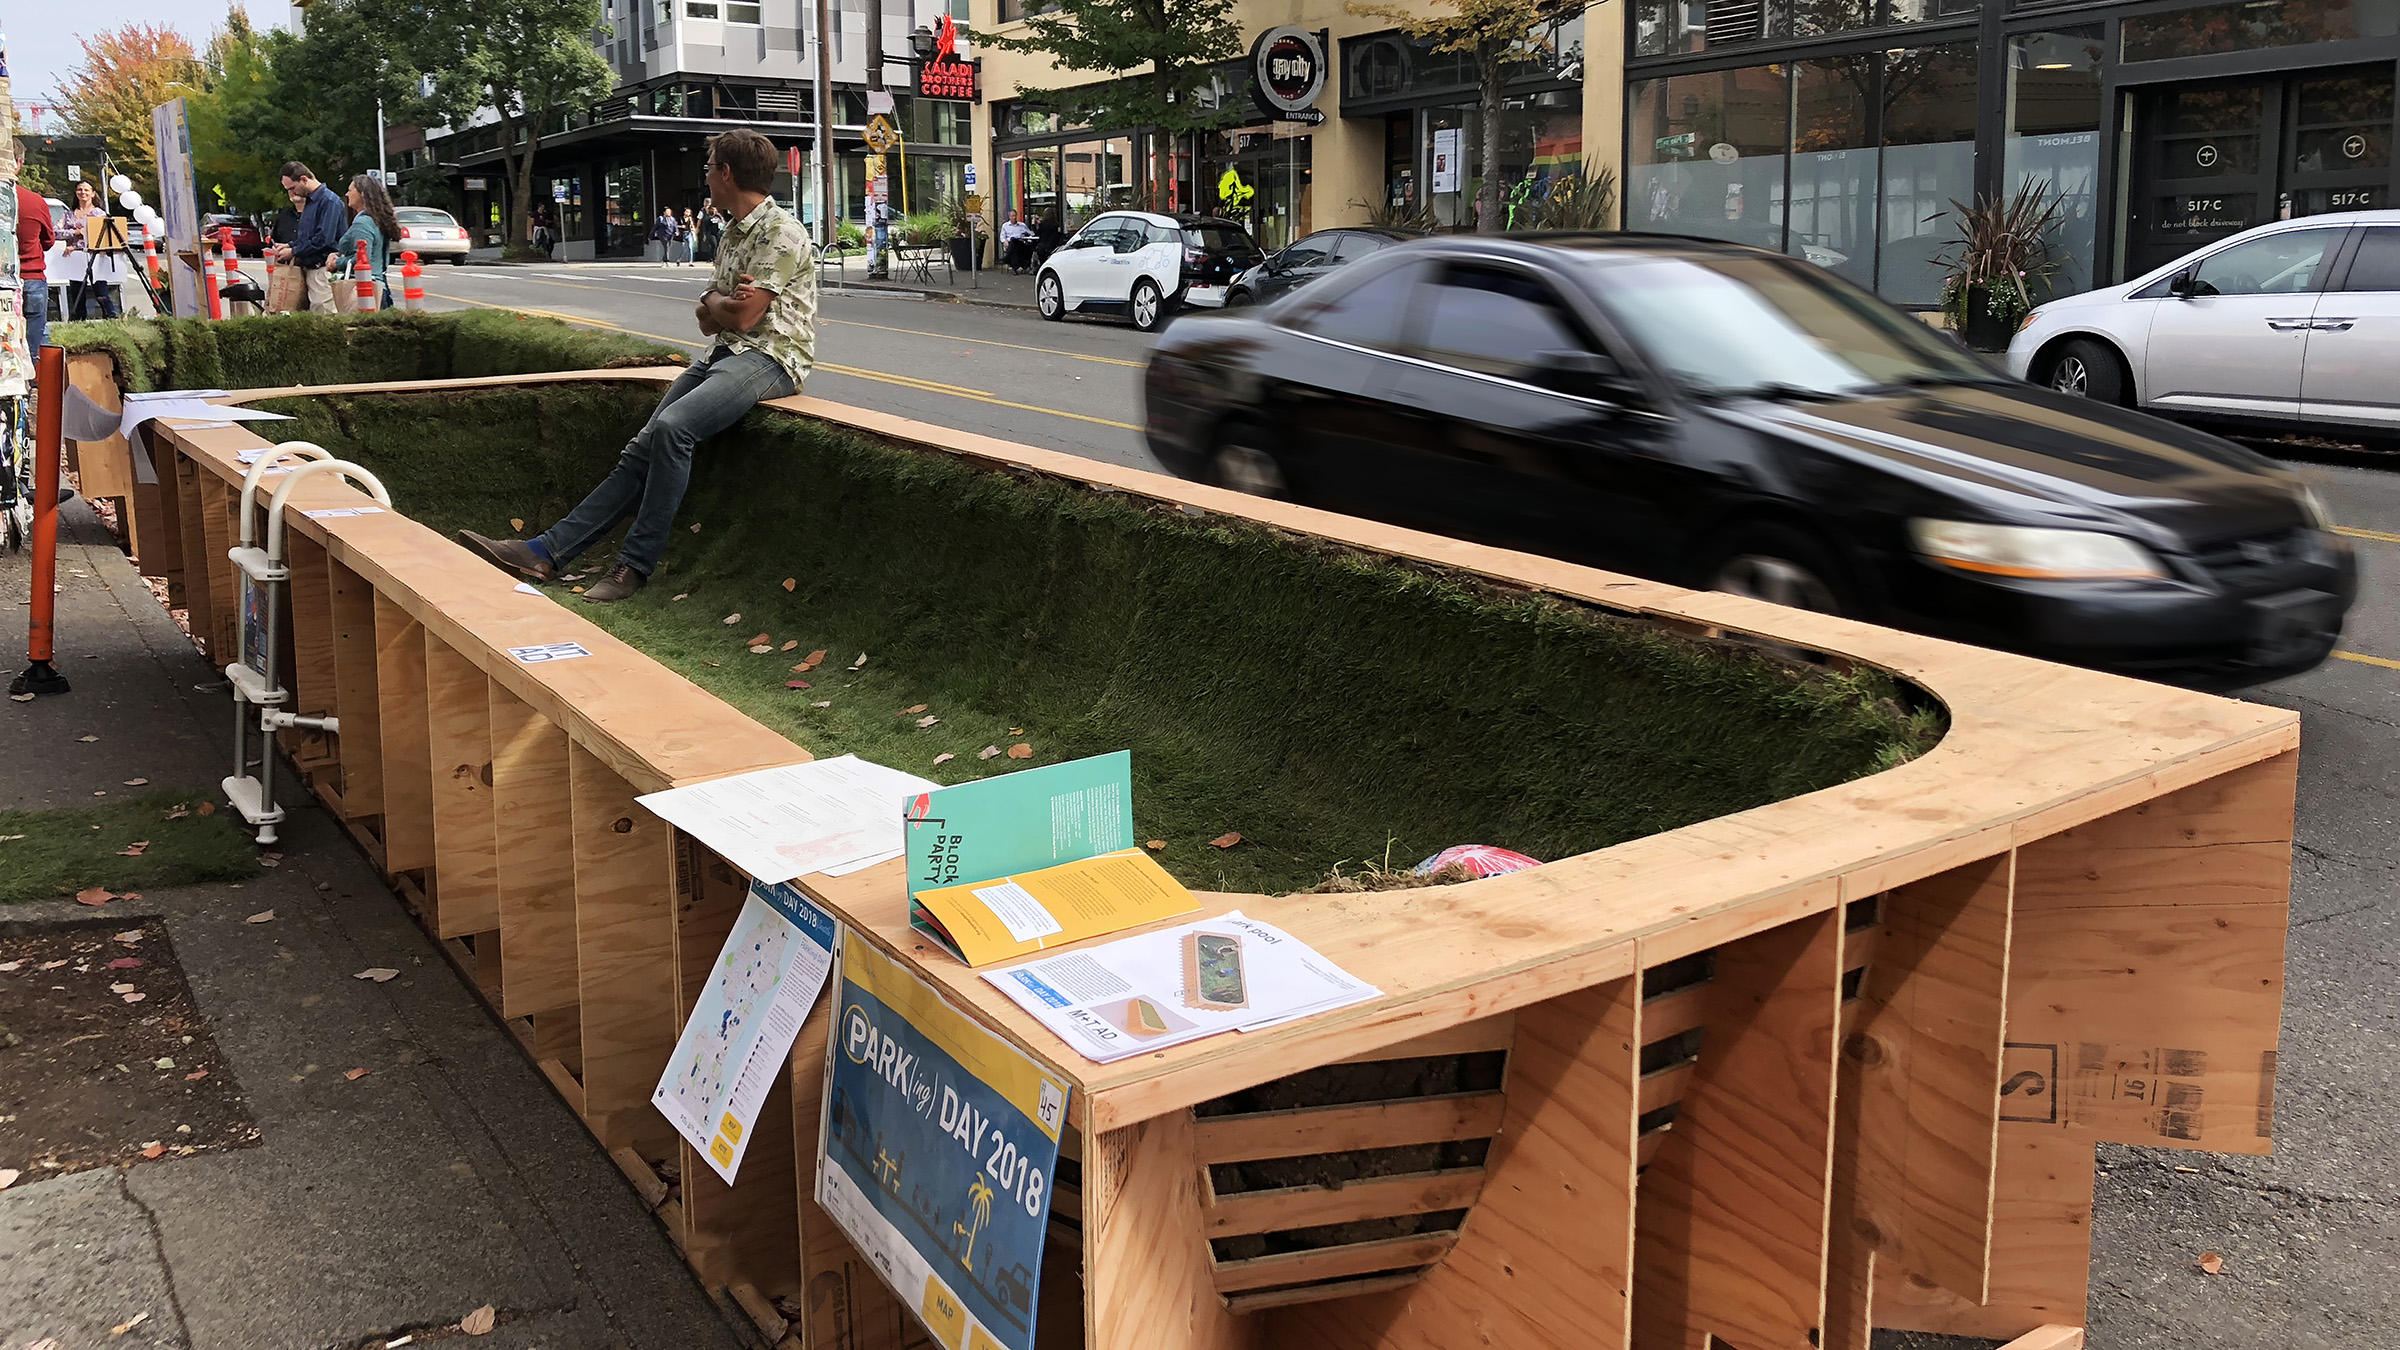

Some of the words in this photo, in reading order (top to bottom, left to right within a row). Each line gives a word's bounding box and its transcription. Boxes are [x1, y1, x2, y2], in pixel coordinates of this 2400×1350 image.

[921, 61, 974, 77] KALADI
[921, 74, 974, 87] BROTHERS
[921, 83, 974, 98] COFFEE
[1285, 111, 1318, 121] ENTRANCE
[1239, 134, 1251, 148] 517
[2161, 219, 2171, 229] do
[2173, 219, 2186, 229] not
[2188, 217, 2208, 228] block
[923, 834, 947, 885] PARTY
[783, 890, 798, 913] DAY
[799, 903, 818, 928] 2018
[1246, 928, 1283, 945] pool
[1092, 1027, 1118, 1041] AD
[850, 1013, 938, 1120] PARK(ing)
[938, 1084, 989, 1160] DAY
[985, 1130, 1044, 1218] 2018
[937, 1294, 954, 1321] MAP
